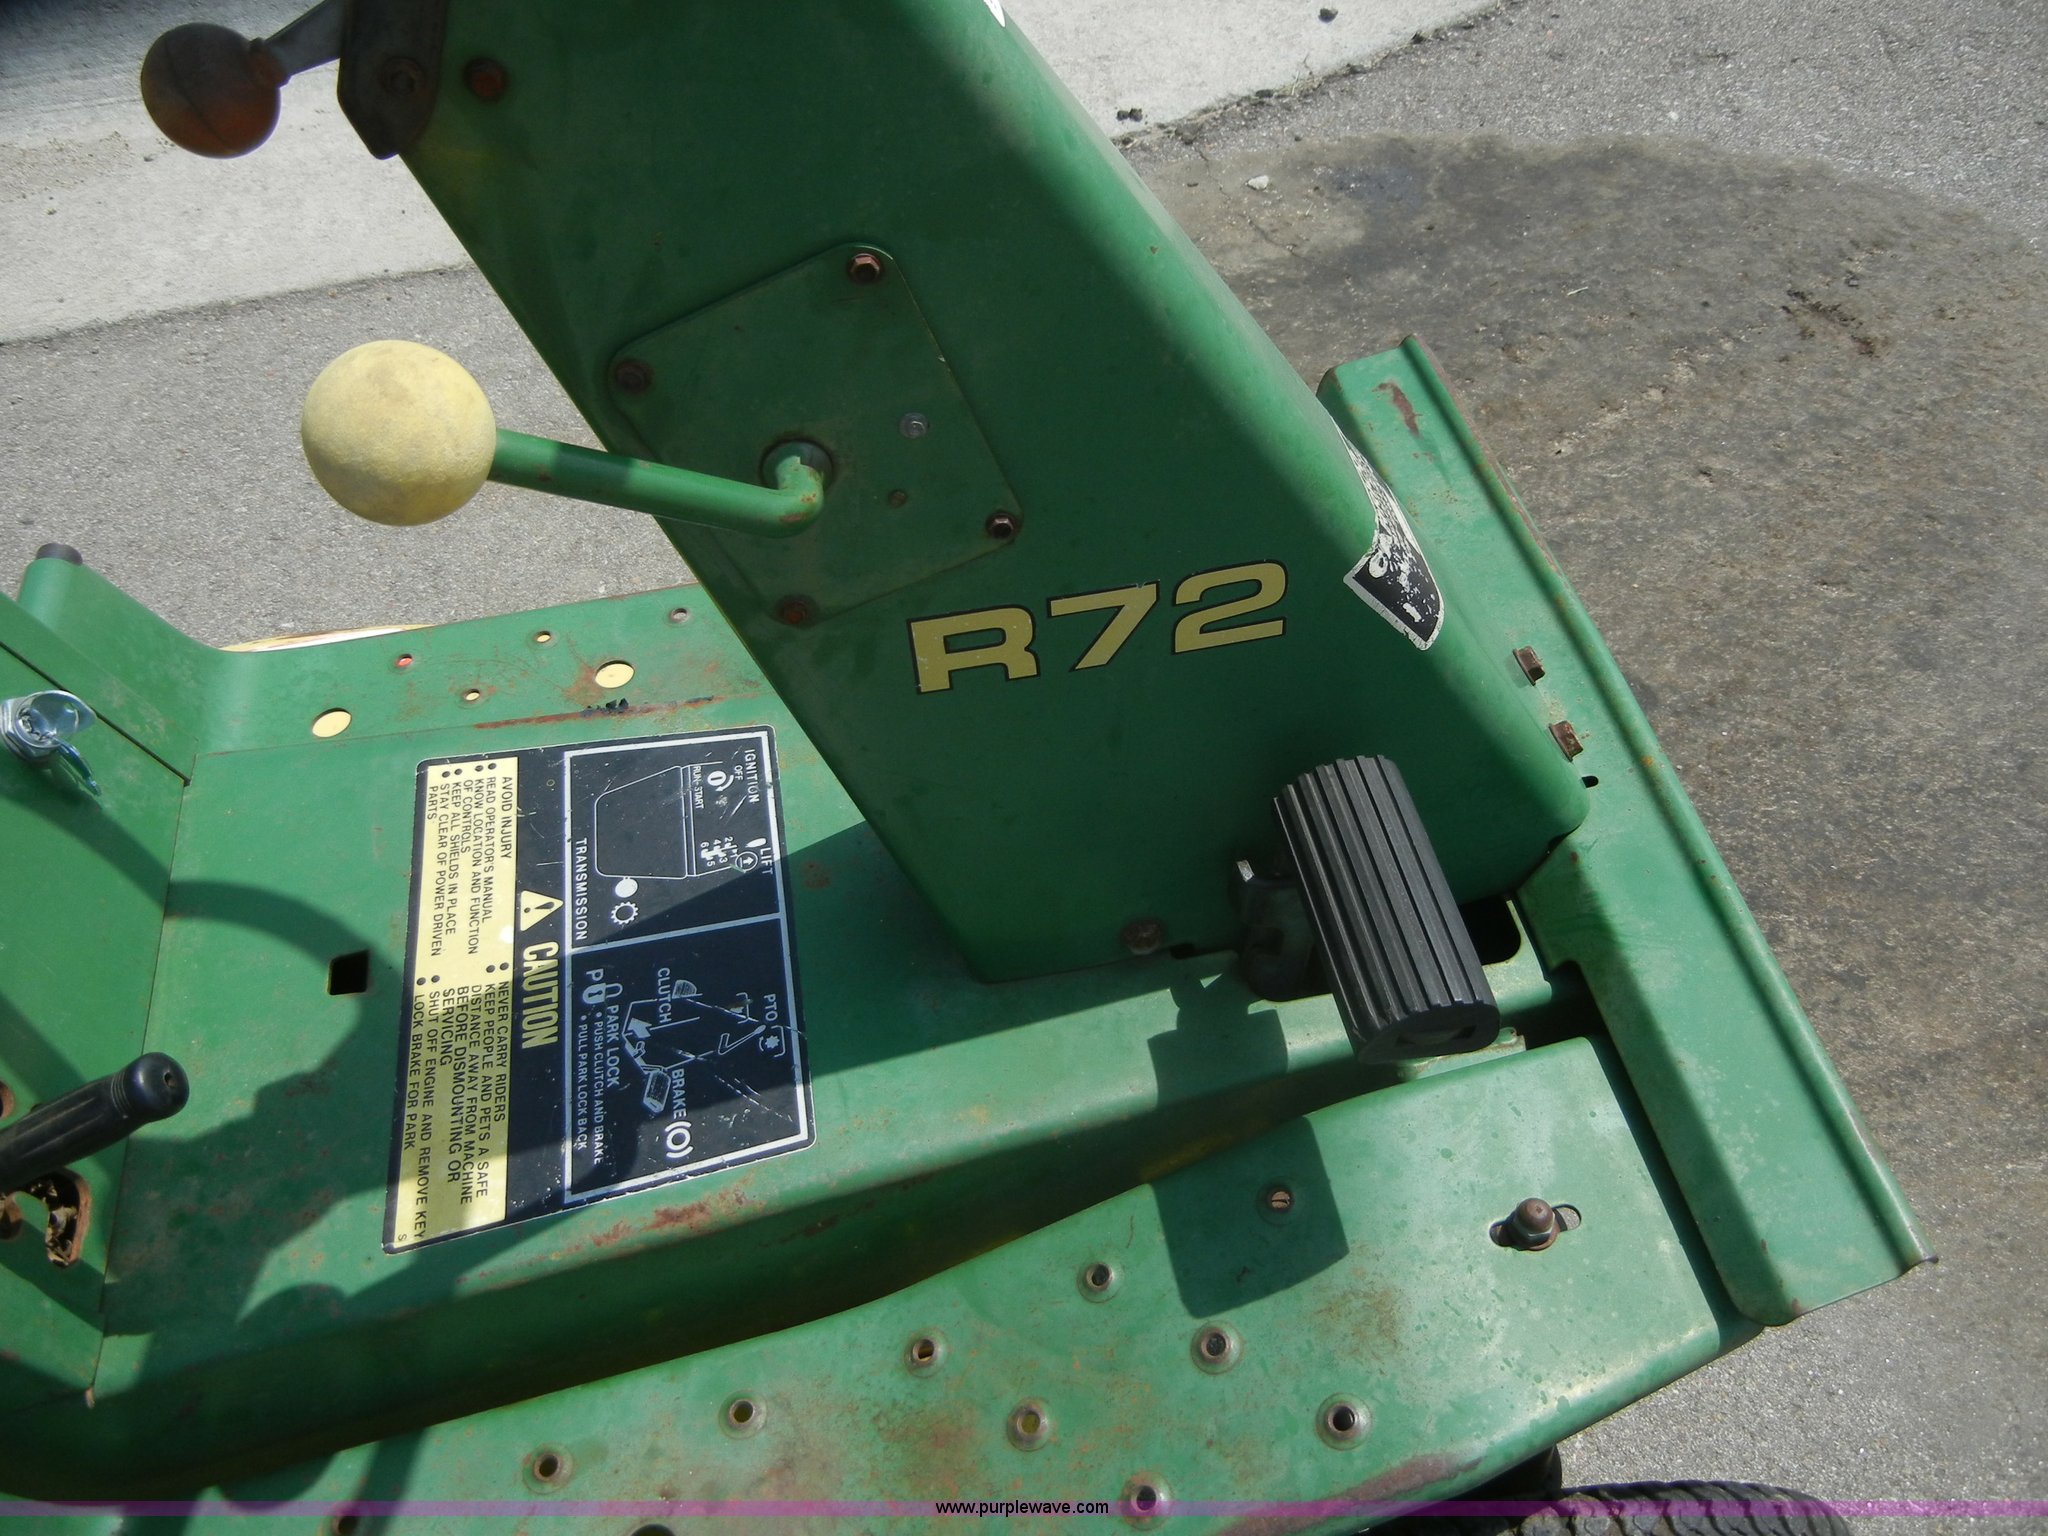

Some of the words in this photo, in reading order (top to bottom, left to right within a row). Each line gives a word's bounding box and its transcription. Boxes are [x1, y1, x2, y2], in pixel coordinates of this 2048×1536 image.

[907, 560, 1289, 694] R72
[464, 780, 473, 793] OF
[734, 765, 744, 780] OFF
[744, 749, 760, 803] IGNITION
[428, 786, 438, 820] PARTS
[440, 783, 450, 810] STAY
[451, 782, 462, 808] KEEP
[474, 778, 484, 810] KNOW
[486, 777, 496, 805] READ
[502, 776, 512, 812] AVOID
[438, 815, 448, 848] CLEAR
[450, 812, 460, 832] ALL
[461, 797, 473, 853] CONTROLS
[484, 808, 496, 872] OPERATOR'S
[500, 816, 512, 859] INJURY
[448, 835, 460, 879] SHIELDS
[472, 814, 484, 867] LOCATION
[436, 852, 447, 866] OF
[760, 848, 774, 874] LIFT
[434, 870, 446, 908] POWER
[447, 884, 458, 894] IN
[470, 871, 482, 893] AND
[482, 876, 494, 923] MANUAL
[576, 838, 588, 940] TRANSMISSION
[431, 914, 444, 956] DRIVEN
[445, 898, 456, 936] PLACE
[468, 897, 480, 954] FUNCTION
[586, 968, 604, 981] P
[412, 994, 425, 1029] LOCK
[428, 991, 440, 1023] SHUT
[484, 984, 496, 1015] KEEP
[498, 981, 510, 1022] NEVER
[522, 941, 559, 1049] CAUTION
[657, 967, 672, 1024] CLUTCH
[764, 994, 778, 1021] PTO
[440, 989, 456, 1066] SERVICING
[454, 986, 470, 1043] BEFORE
[469, 984, 482, 1048] DISTANCE
[606, 1004, 620, 1044] PARK
[426, 1028, 438, 1052] OFF
[482, 1020, 495, 1070] PEOPLE
[496, 1026, 509, 1068] CARRY
[578, 1024, 588, 1052] PULL
[594, 1021, 604, 1050] PUSH
[409, 1034, 423, 1078] BRAKE
[466, 1054, 480, 1092] AWAY
[578, 1054, 588, 1082] PARK
[594, 1051, 604, 1097] CLUTCH
[606, 1048, 620, 1088] LOCK
[406, 1082, 420, 1108] FOR
[422, 1058, 436, 1108] ENGINE
[448, 1046, 467, 1154] DISMOUNTING
[480, 1076, 492, 1102] AND
[494, 1074, 507, 1122] RIDERS
[578, 1084, 588, 1115] LOCK
[671, 1068, 687, 1119] BRAKE
[420, 1114, 432, 1141] AND
[464, 1096, 478, 1135] FROM
[478, 1107, 492, 1141] PETS
[594, 1099, 604, 1124] AND
[404, 1114, 418, 1150] PARK
[577, 1118, 588, 1150] BACK
[594, 1125, 604, 1164] BRAKE
[478, 1147, 490, 1156] A
[416, 1147, 431, 1206] REMOVE
[448, 1160, 462, 1183] OR
[460, 1141, 476, 1205] MACHINE
[476, 1162, 490, 1198] SAFE
[414, 1210, 427, 1239] KEY
